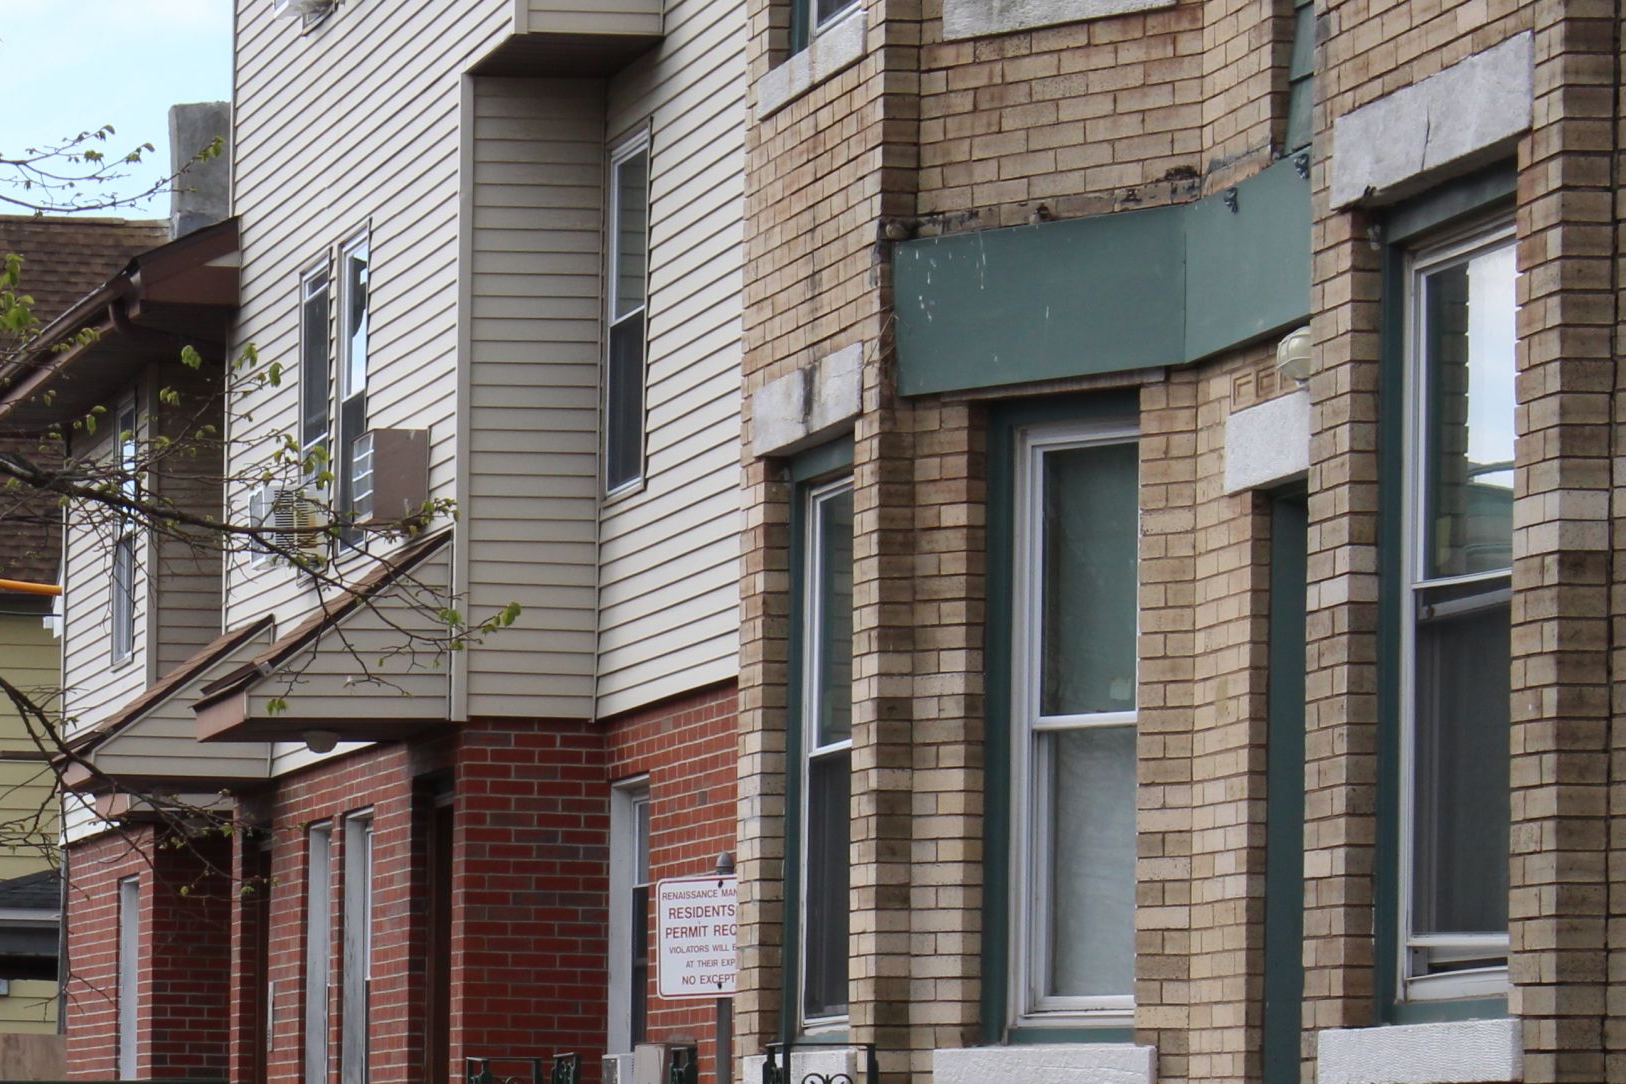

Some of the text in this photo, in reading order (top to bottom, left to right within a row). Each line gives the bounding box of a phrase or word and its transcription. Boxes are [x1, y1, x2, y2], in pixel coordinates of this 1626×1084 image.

[662, 889, 718, 900] RENAISSANCE
[668, 904, 735, 919] RESIDENTS
[665, 925, 709, 939] PERMIT
[669, 944, 710, 954] VIOLATORS
[712, 943, 730, 952] WILL
[686, 960, 694, 968] AT
[697, 959, 719, 968] THEIR
[682, 973, 736, 986] NO EXCEPT
